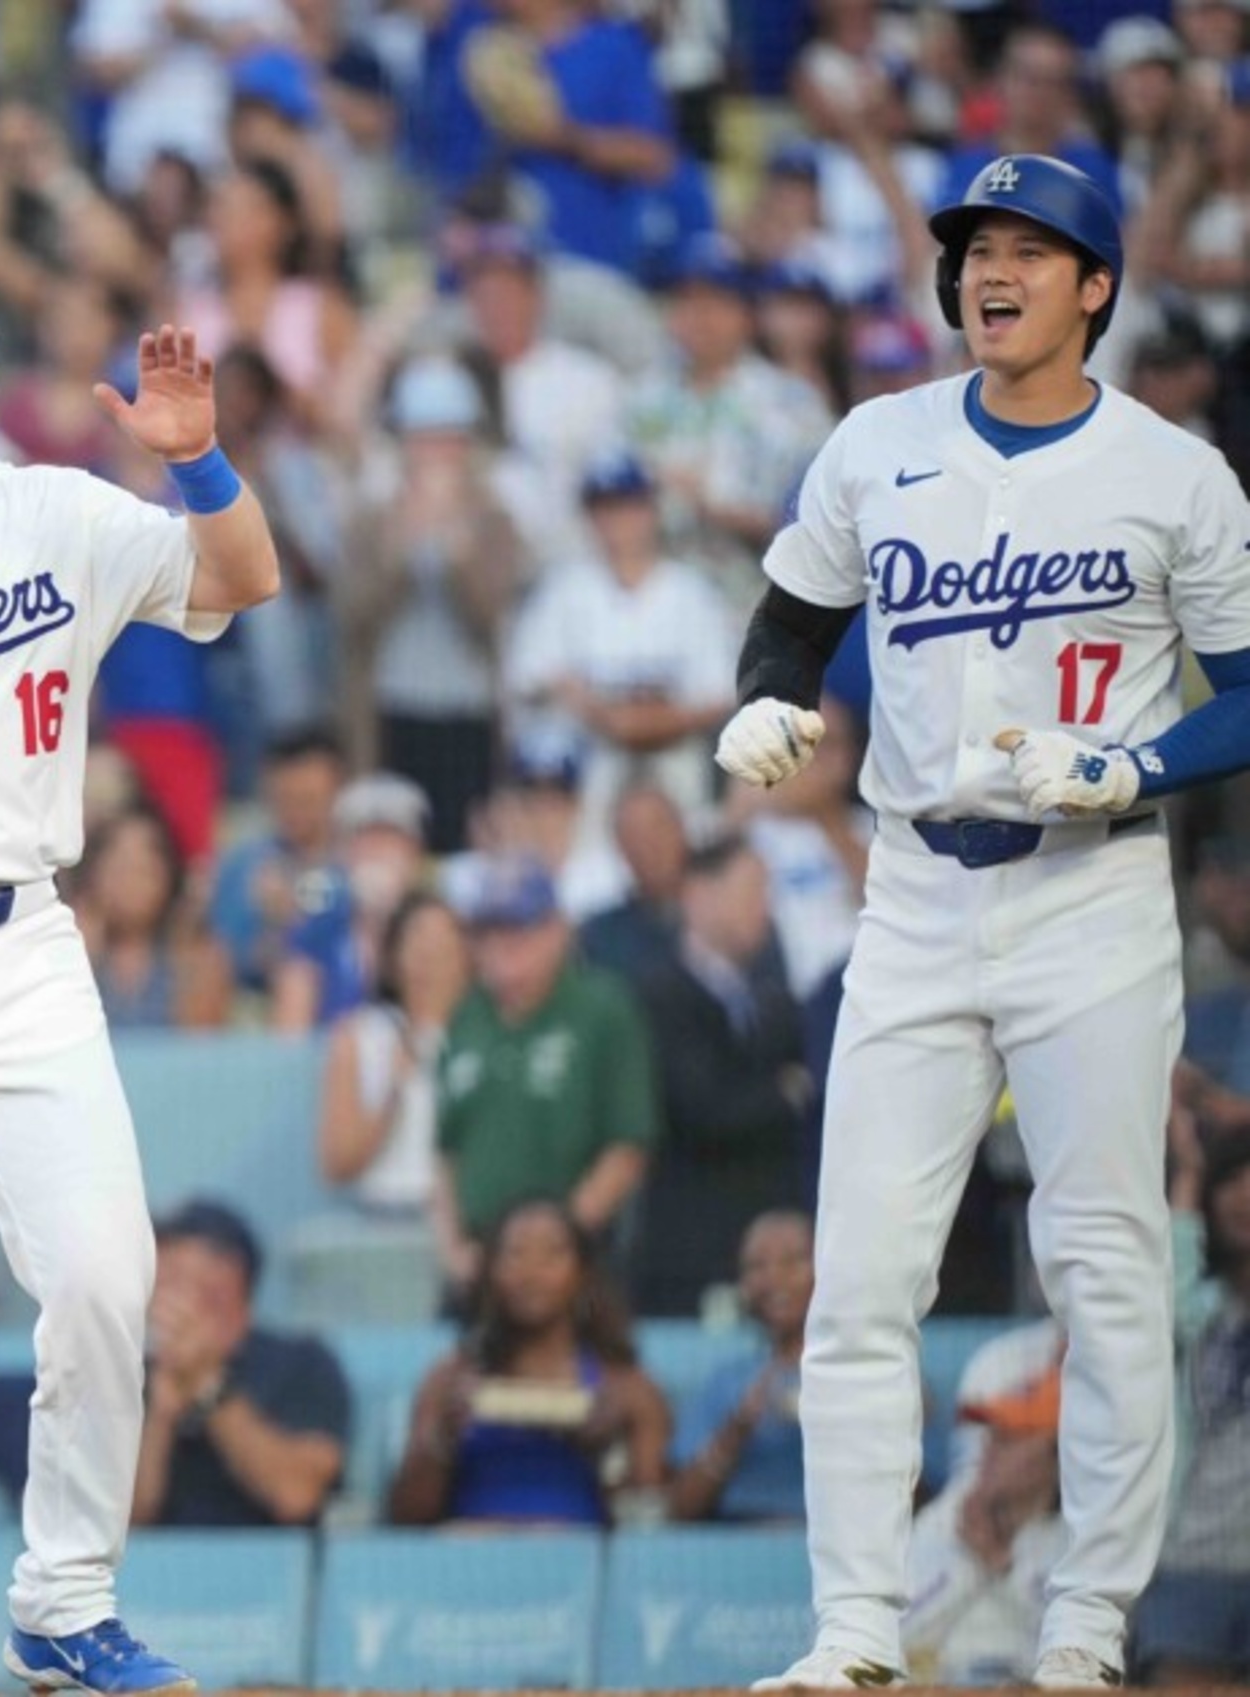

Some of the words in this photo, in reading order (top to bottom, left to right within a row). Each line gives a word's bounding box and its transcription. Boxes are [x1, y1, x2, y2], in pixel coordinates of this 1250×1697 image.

[989, 158, 1021, 192] LA
[868, 532, 1136, 653] Dodgers
[14, 669, 70, 756] 16
[1056, 641, 1123, 726] 17
